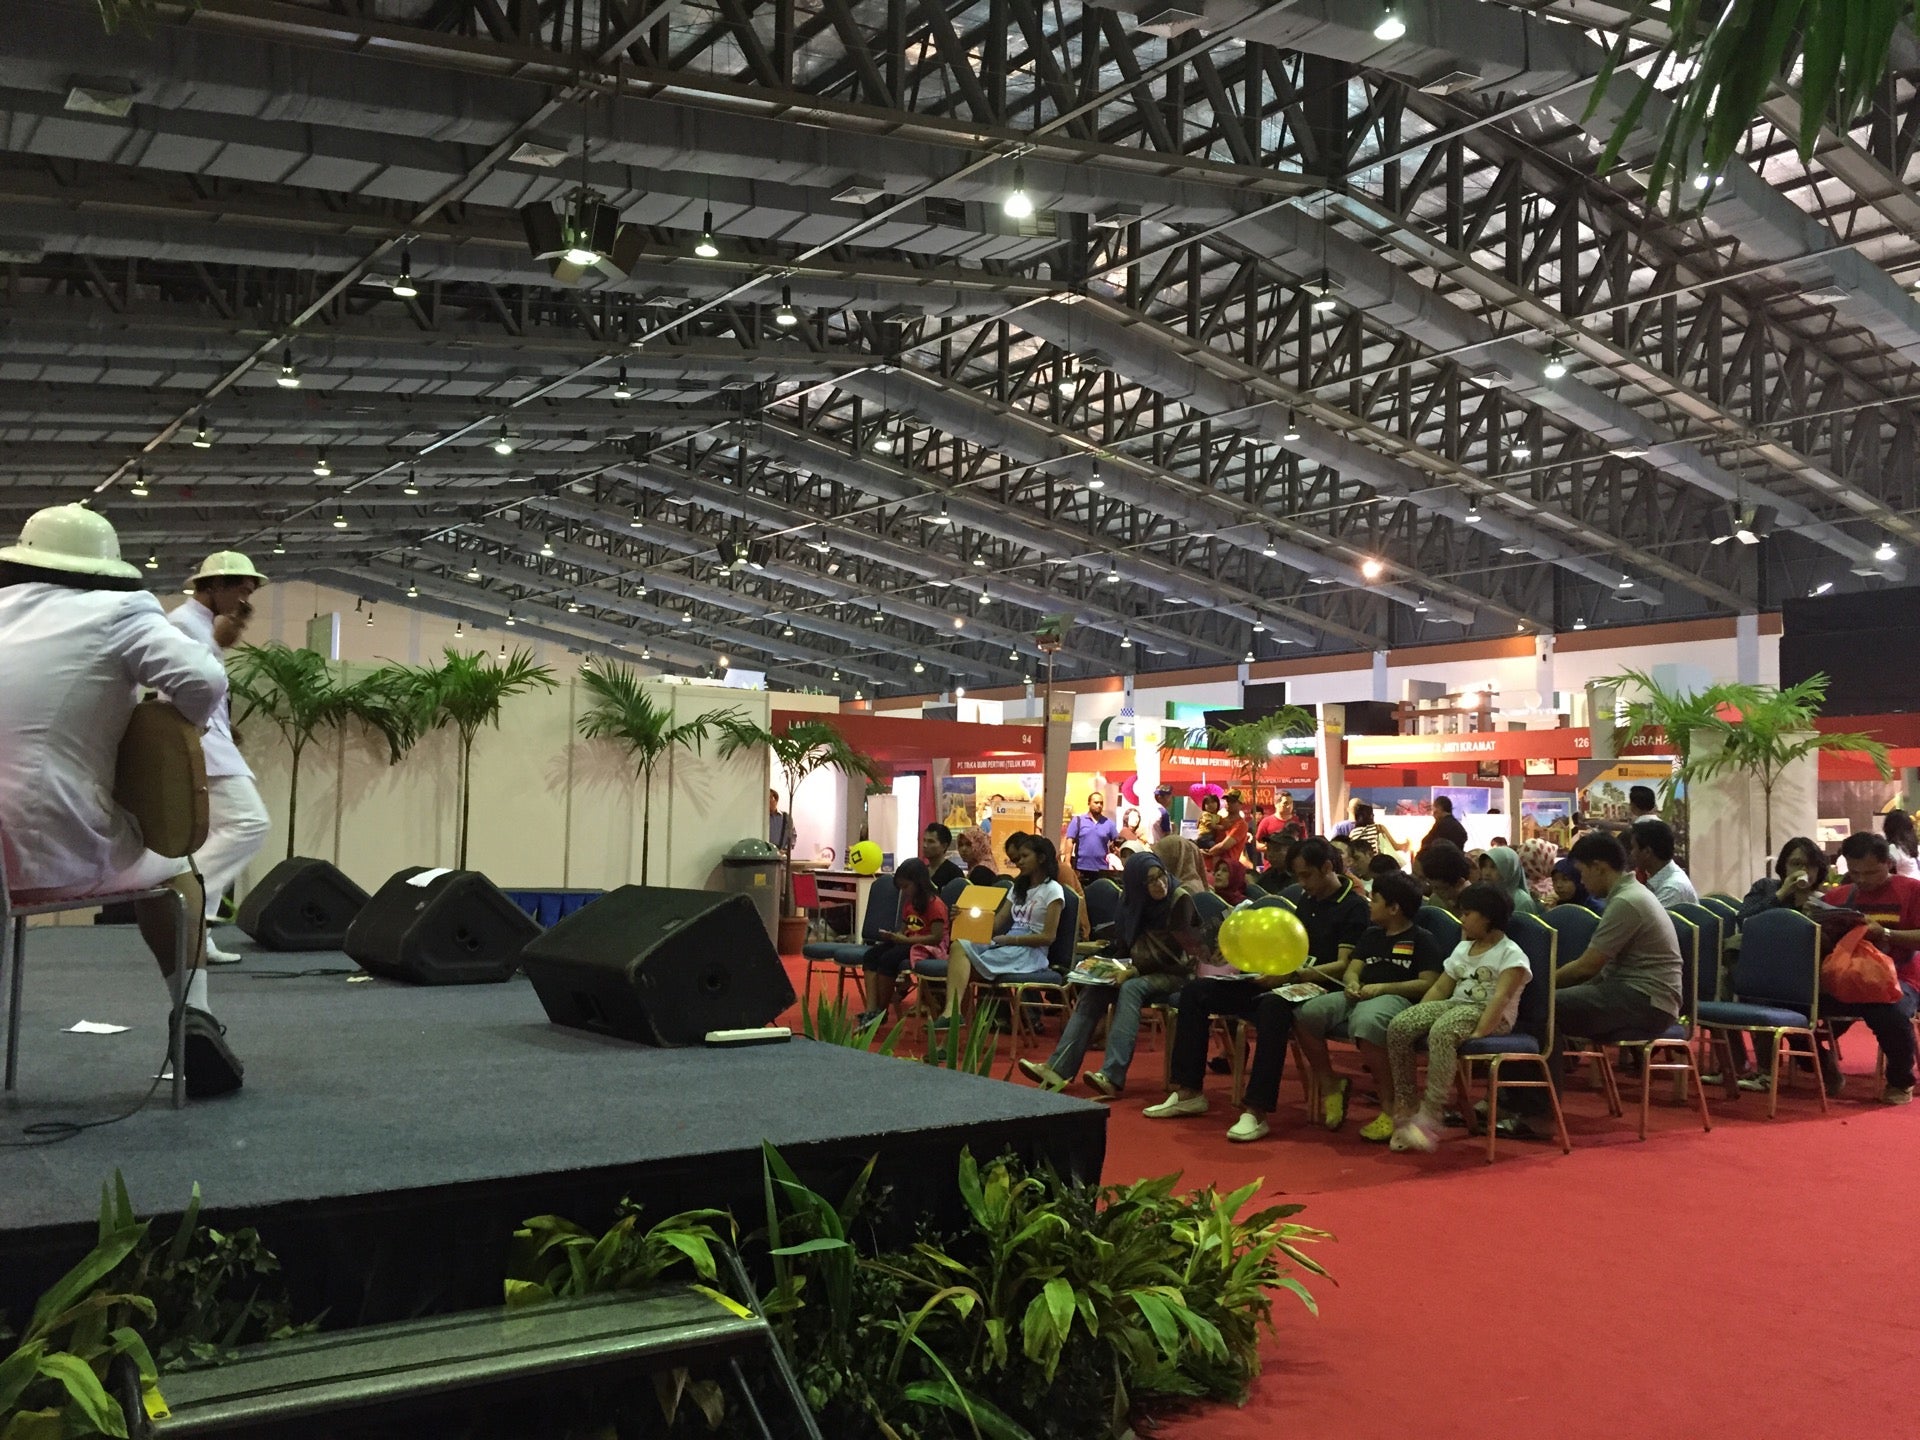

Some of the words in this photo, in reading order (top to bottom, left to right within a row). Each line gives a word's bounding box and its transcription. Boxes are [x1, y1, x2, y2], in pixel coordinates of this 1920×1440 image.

[1022, 734, 1032, 744] 94
[1574, 737, 1590, 748] 126
[1459, 740, 1496, 752] KRAMAT
